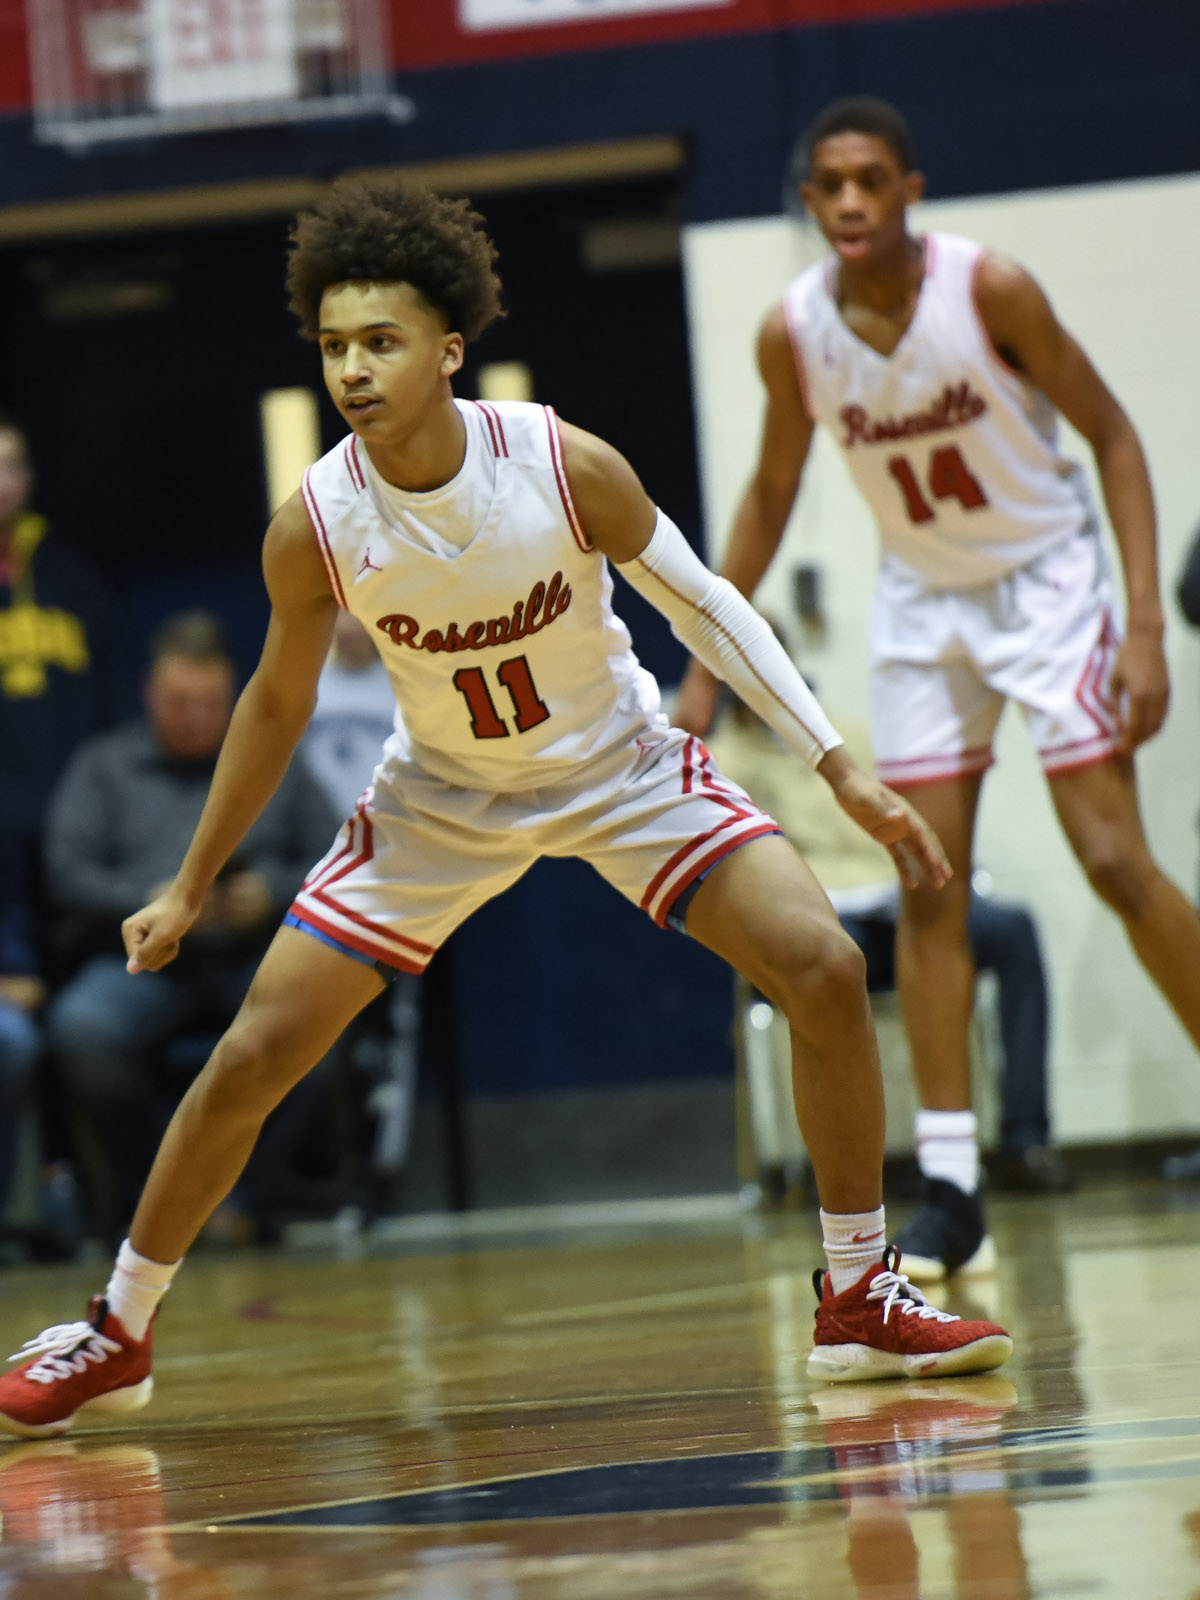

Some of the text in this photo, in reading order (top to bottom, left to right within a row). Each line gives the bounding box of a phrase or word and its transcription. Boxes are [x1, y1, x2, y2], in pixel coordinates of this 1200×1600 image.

[887, 444, 989, 525] 14
[376, 570, 573, 653] Roseville
[452, 654, 551, 740] 11
